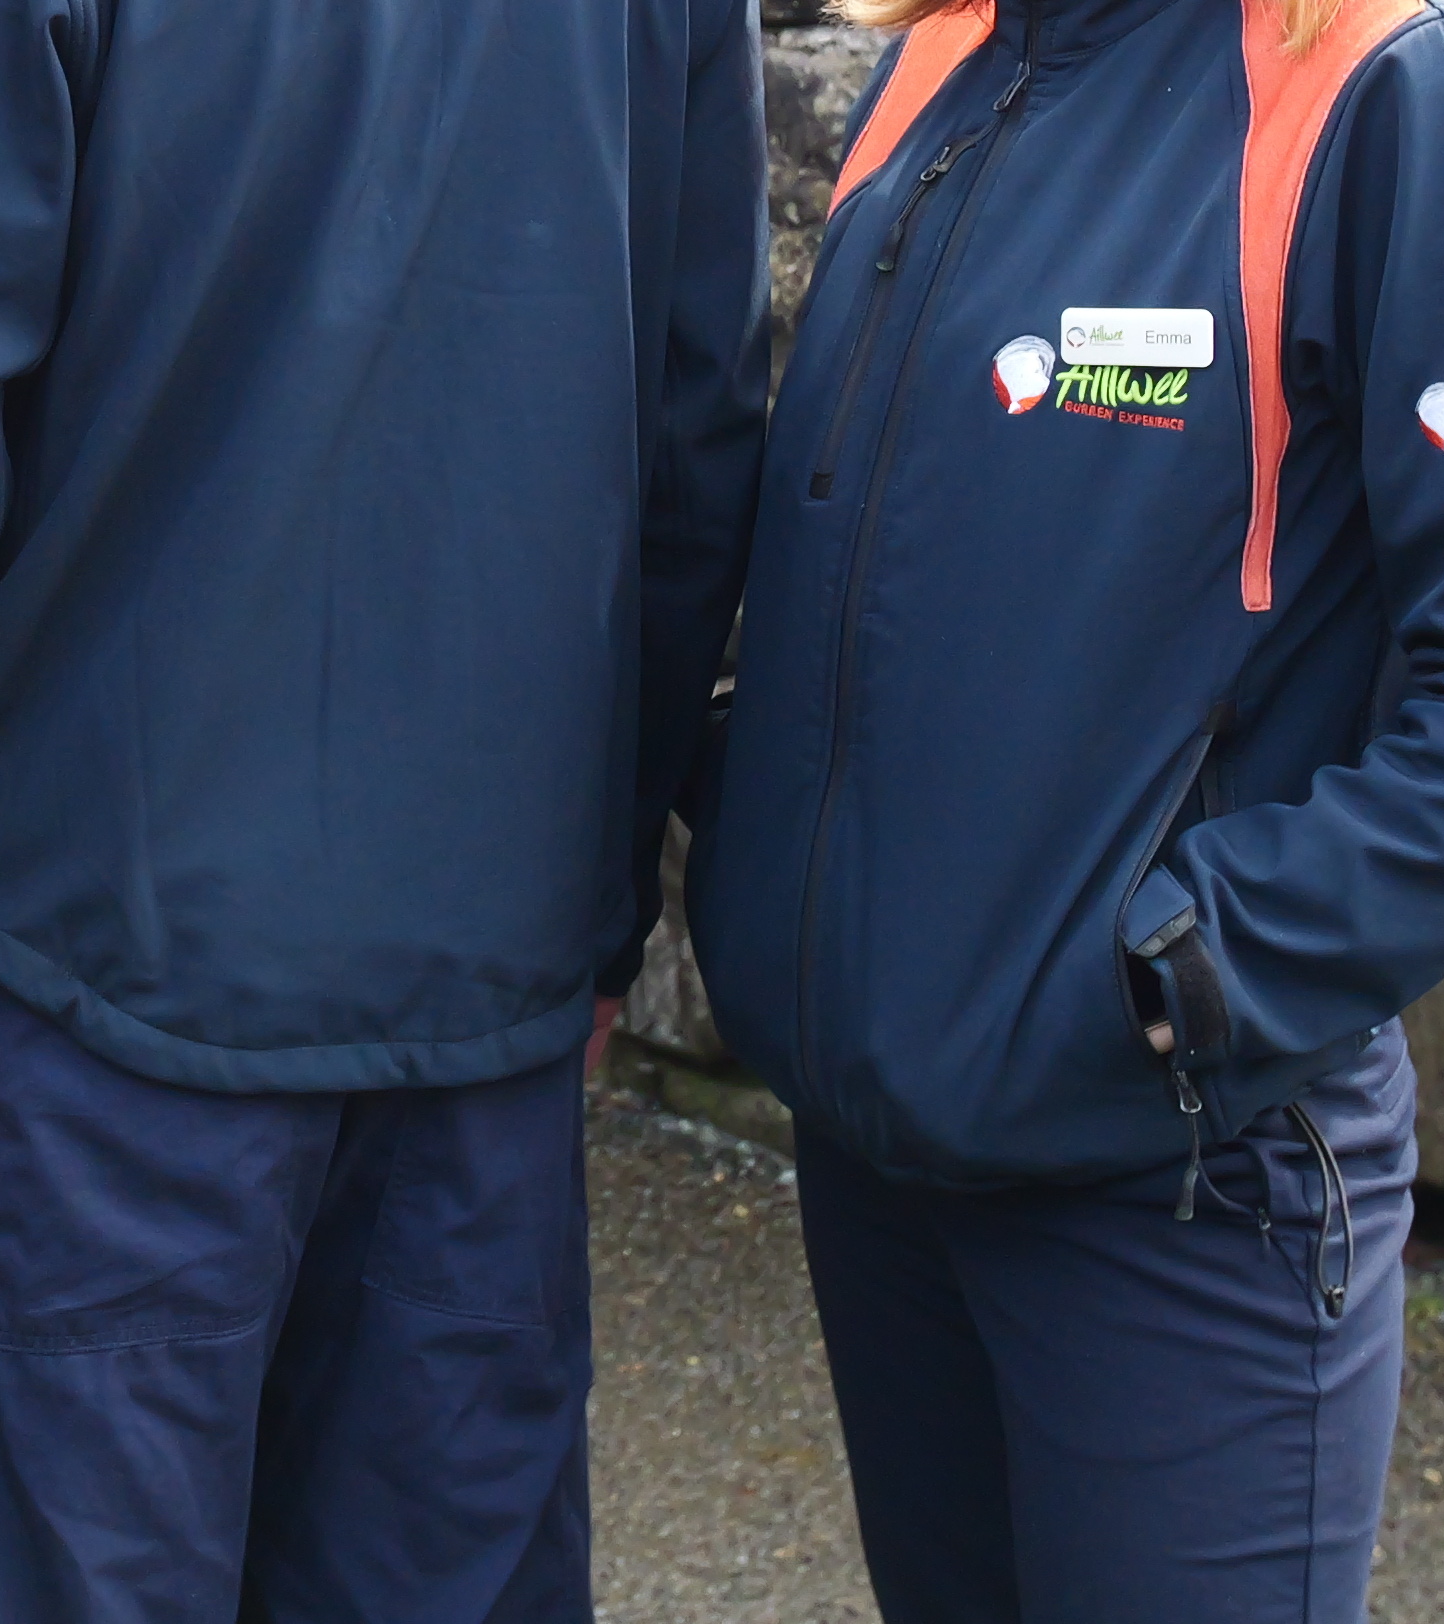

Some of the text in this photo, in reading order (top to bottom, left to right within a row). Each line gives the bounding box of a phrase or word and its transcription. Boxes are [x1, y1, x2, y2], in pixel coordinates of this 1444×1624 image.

[1089, 325, 1192, 345] Aillwee Emma
[1055, 365, 1189, 410] Aillwee
[1119, 411, 1184, 431] EXPERIENCE
